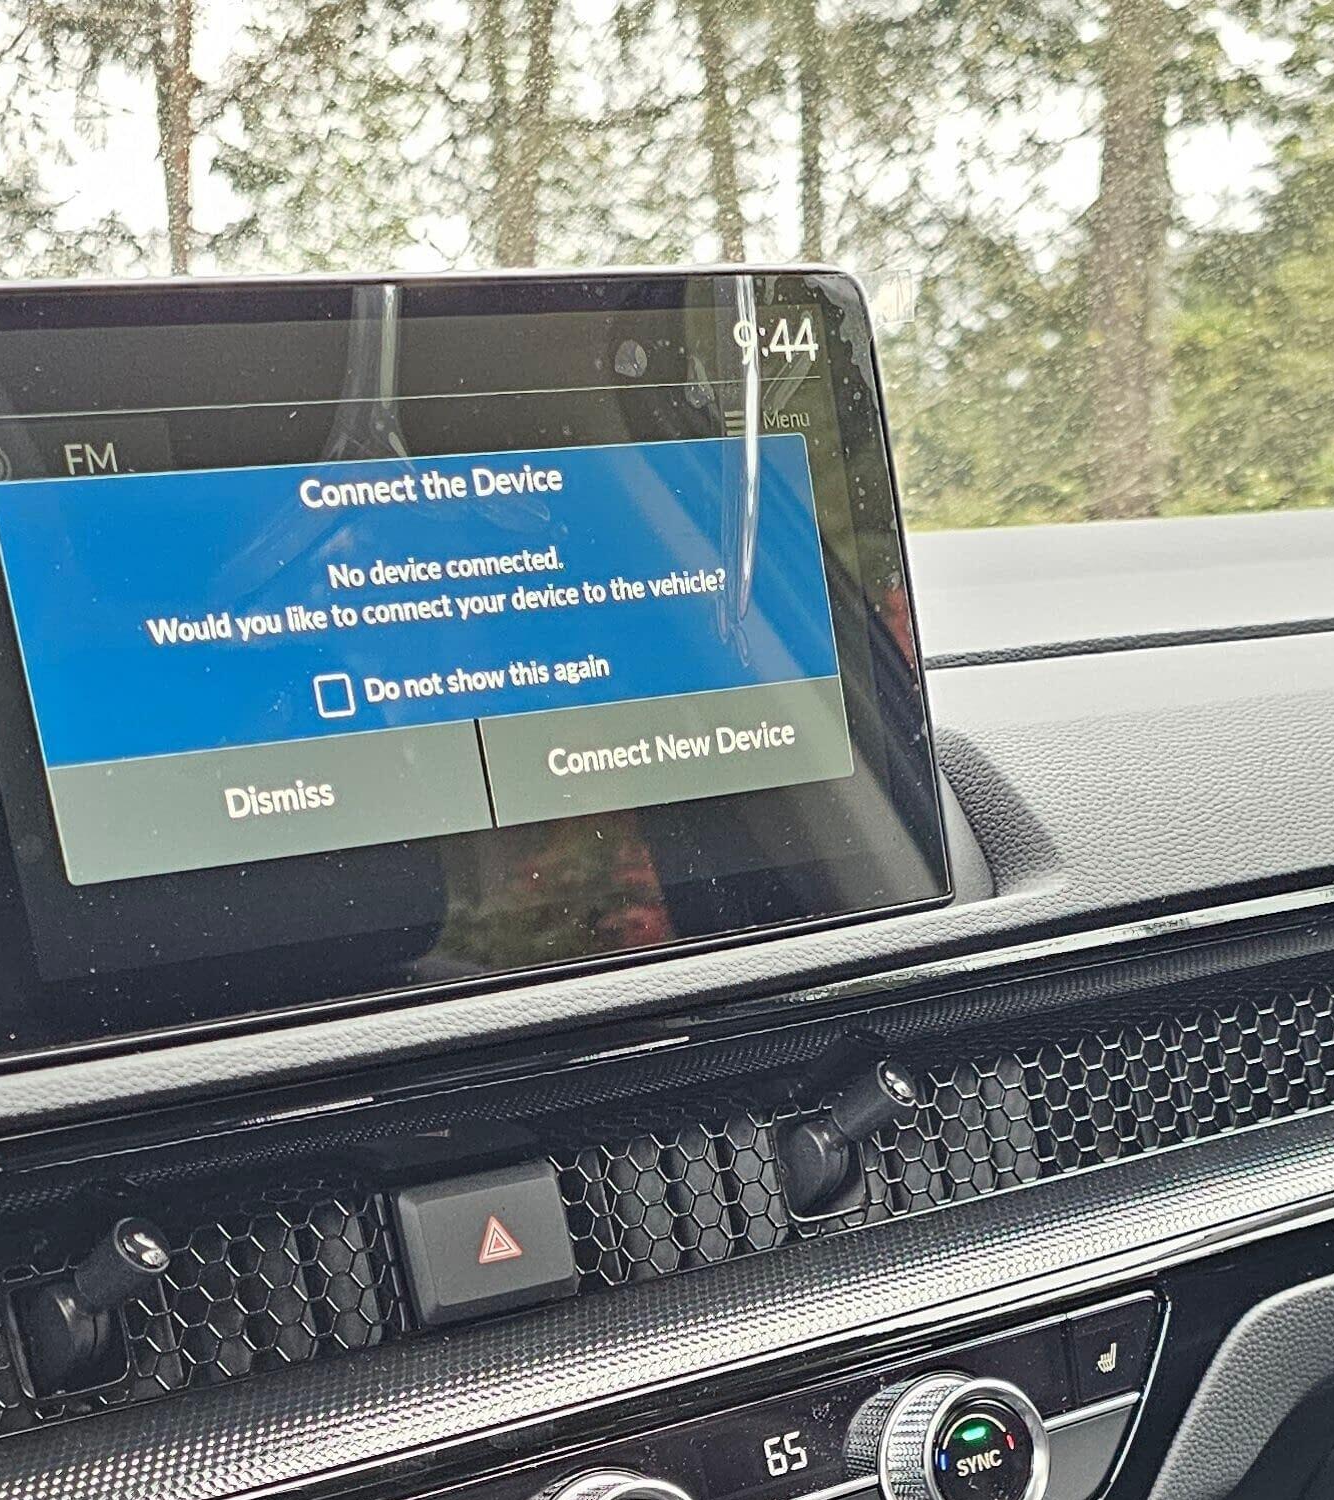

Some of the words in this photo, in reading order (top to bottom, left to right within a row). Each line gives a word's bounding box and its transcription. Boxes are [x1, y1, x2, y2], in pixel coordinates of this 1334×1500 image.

[733, 318, 818, 364] 9:44
[763, 408, 810, 430] Menu
[66, 443, 118, 475] FM
[300, 474, 416, 510] Connect
[423, 470, 467, 499] the
[474, 467, 562, 496] Device
[328, 564, 365, 588] No
[370, 557, 442, 585] device
[446, 547, 564, 580] connected.
[146, 615, 231, 646] Would
[236, 613, 282, 641] you
[287, 606, 327, 633] like
[330, 606, 356, 629] to
[363, 596, 452, 626] connect
[457, 590, 506, 622] your
[511, 585, 579, 611] device
[584, 582, 606, 603] to
[610, 578, 644, 600] the
[648, 569, 725, 594] vehicle?
[364, 676, 399, 703] Do
[401, 674, 442, 697] not
[446, 667, 504, 694] show
[509, 661, 549, 686] this
[553, 656, 610, 687] again
[547, 740, 650, 778] Connect
[655, 734, 710, 764] New
[715, 721, 796, 754] Device
[224, 780, 336, 819] Dismiss
[763, 1431, 808, 1477] 65
[955, 1449, 1004, 1477] SYNC
